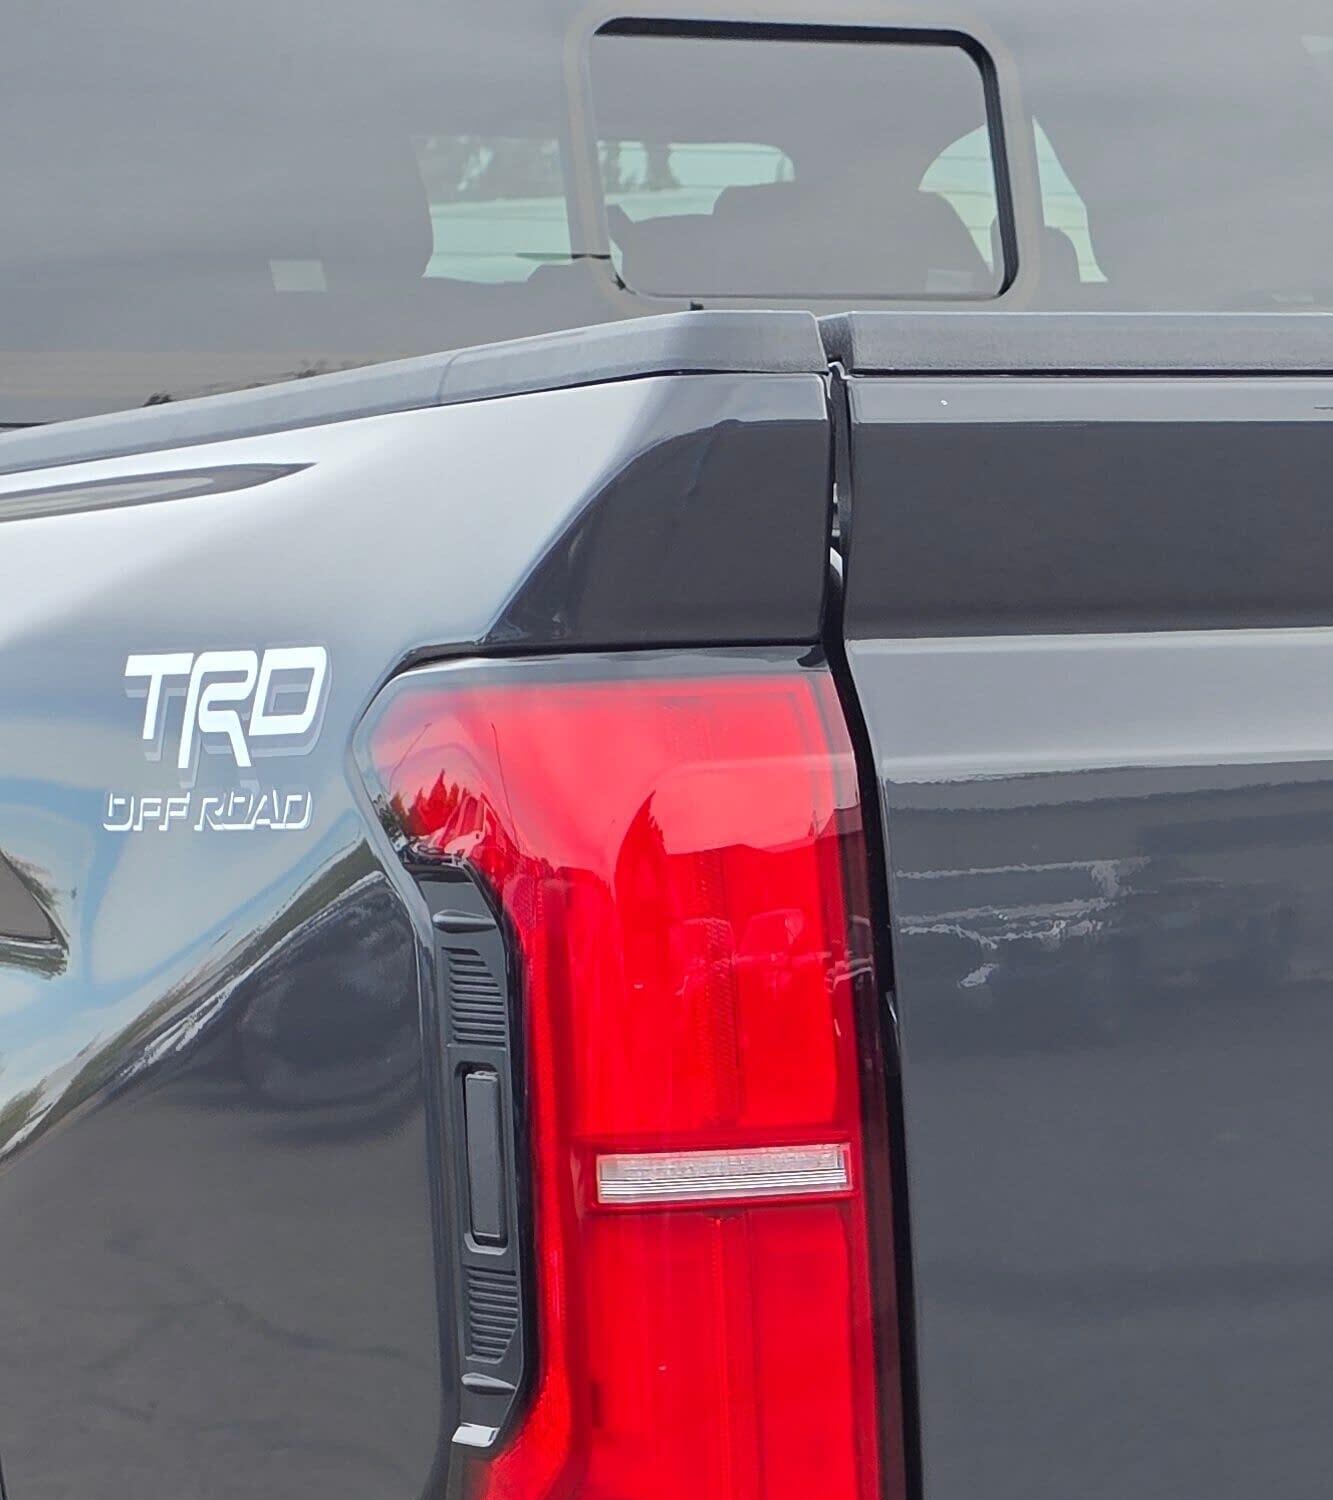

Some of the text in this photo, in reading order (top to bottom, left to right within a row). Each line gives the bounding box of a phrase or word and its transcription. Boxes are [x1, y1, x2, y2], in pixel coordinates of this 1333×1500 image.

[124, 646, 327, 768] TRD
[102, 789, 312, 832] OFF ROAD
